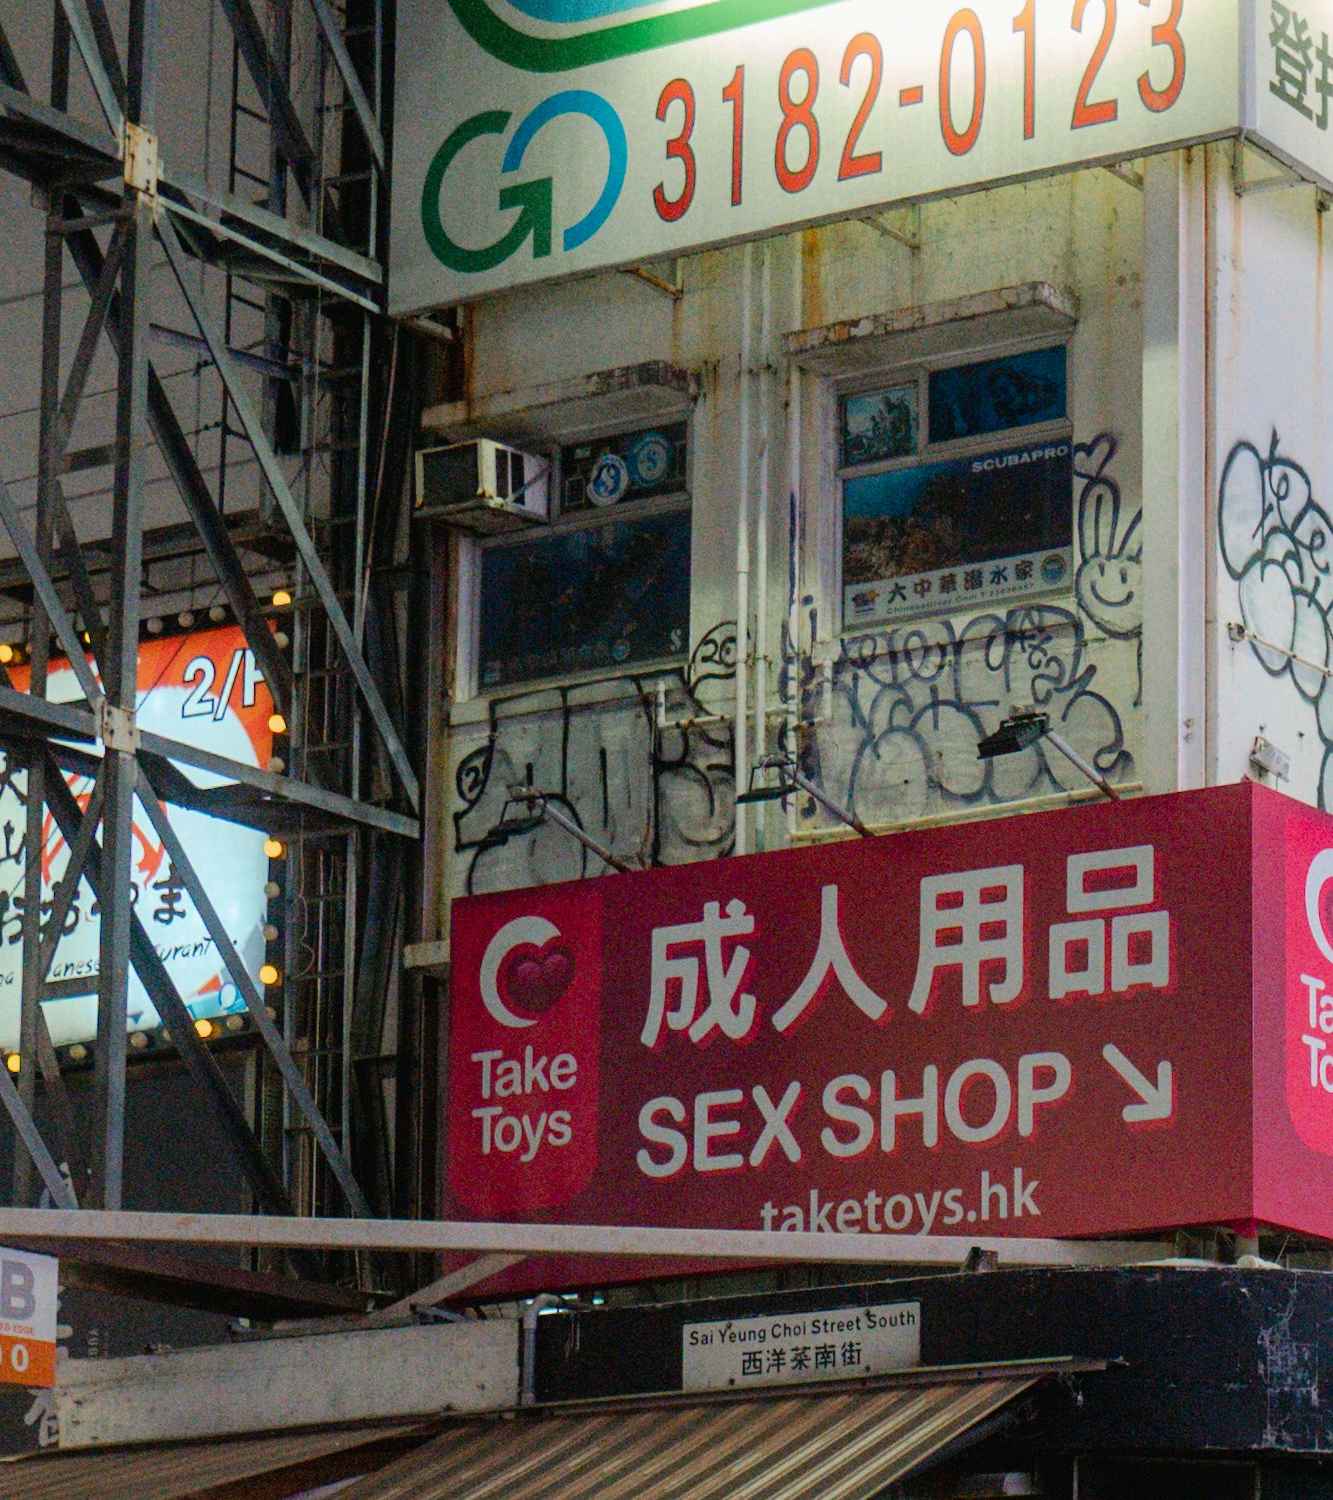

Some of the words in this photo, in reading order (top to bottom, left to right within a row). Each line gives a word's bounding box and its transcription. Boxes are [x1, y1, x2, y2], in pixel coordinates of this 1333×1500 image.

[972, 445, 1068, 472] SCUBAPRO
[640, 844, 1170, 1048] 成人用品
[472, 1047, 578, 1100] Take
[472, 1106, 573, 1163] Toys
[637, 1080, 803, 1179] SEX
[820, 1052, 1072, 1157] SHOP
[760, 1167, 1041, 1237] taketoys.hk
[689, 1329, 714, 1346] Sai
[718, 1324, 766, 1345] Yeung
[771, 1321, 806, 1340] Choi
[811, 1317, 861, 1334] Street
[867, 1310, 916, 1330] South
[741, 1340, 862, 1377] 西洋菜南街
